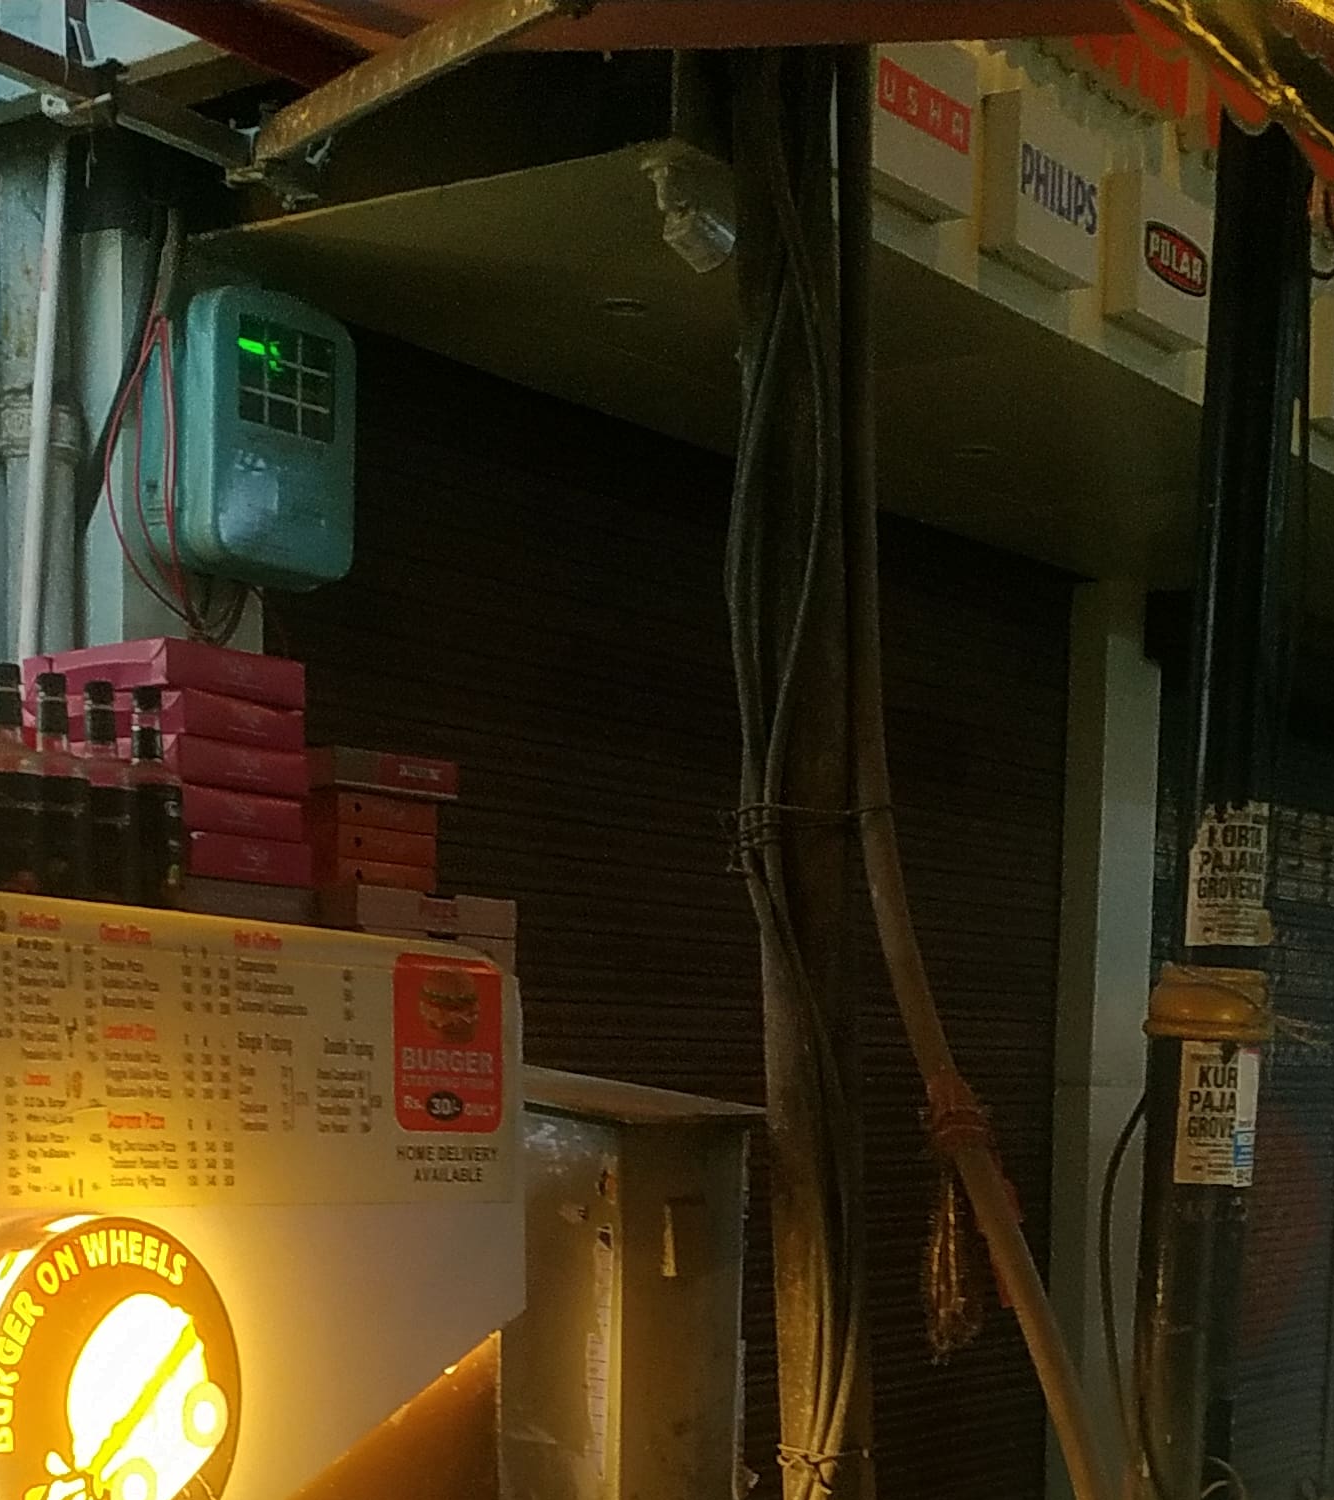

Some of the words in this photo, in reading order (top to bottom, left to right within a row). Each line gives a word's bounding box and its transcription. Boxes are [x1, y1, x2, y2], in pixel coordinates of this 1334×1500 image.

[1021, 142, 1097, 236] PHILIPS
[1149, 231, 1204, 285] POLAR
[402, 1047, 493, 1074] BURGER
[1198, 1066, 1238, 1089] KUR
[1188, 1090, 1236, 1113] PAJA
[1187, 1116, 1235, 1138] GROVE
[396, 1145, 436, 1161] HOME
[438, 1145, 499, 1162] DELIVERY
[414, 1167, 482, 1183] AVAILABLE
[35, 1243, 80, 1295] ON
[78, 1229, 188, 1286] WHEELS
